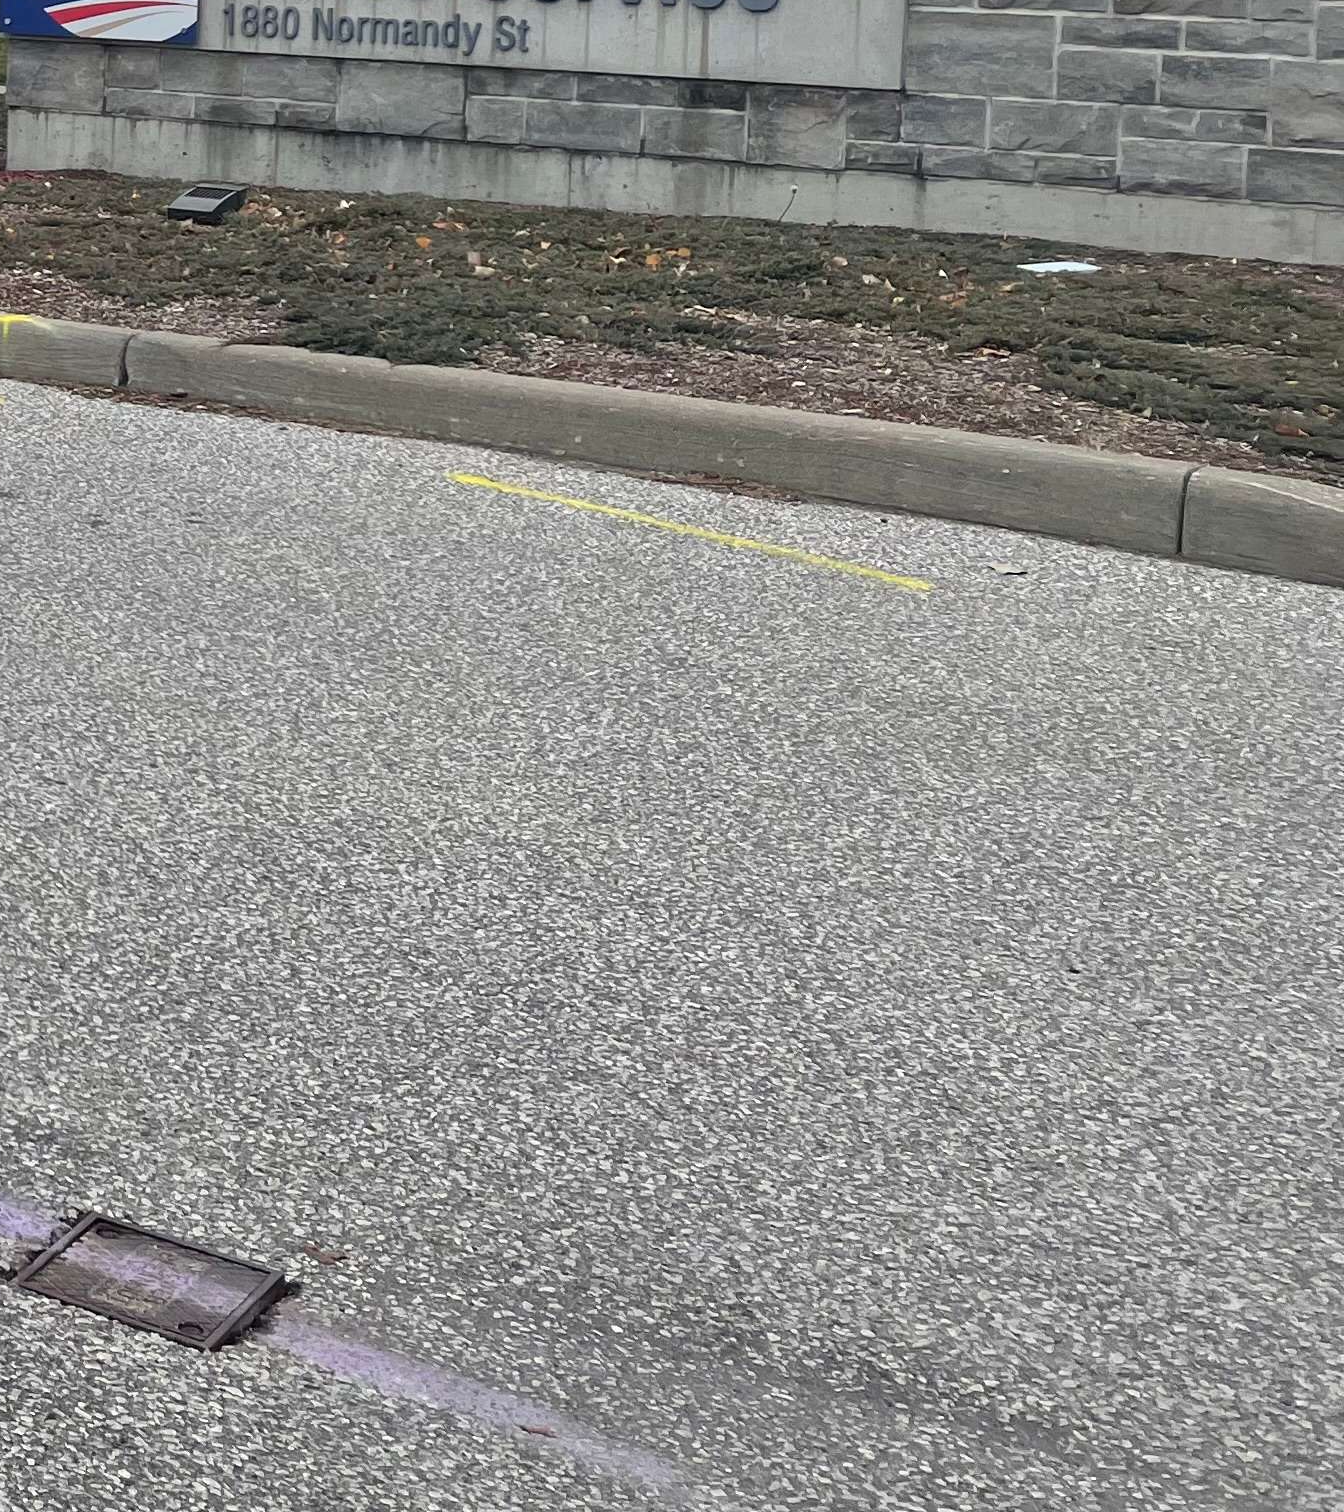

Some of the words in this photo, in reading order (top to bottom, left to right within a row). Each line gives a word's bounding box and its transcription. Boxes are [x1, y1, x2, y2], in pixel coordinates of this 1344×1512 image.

[223, 2, 301, 40] 1880
[312, 6, 483, 57] Normandy
[494, 14, 531, 53] St
